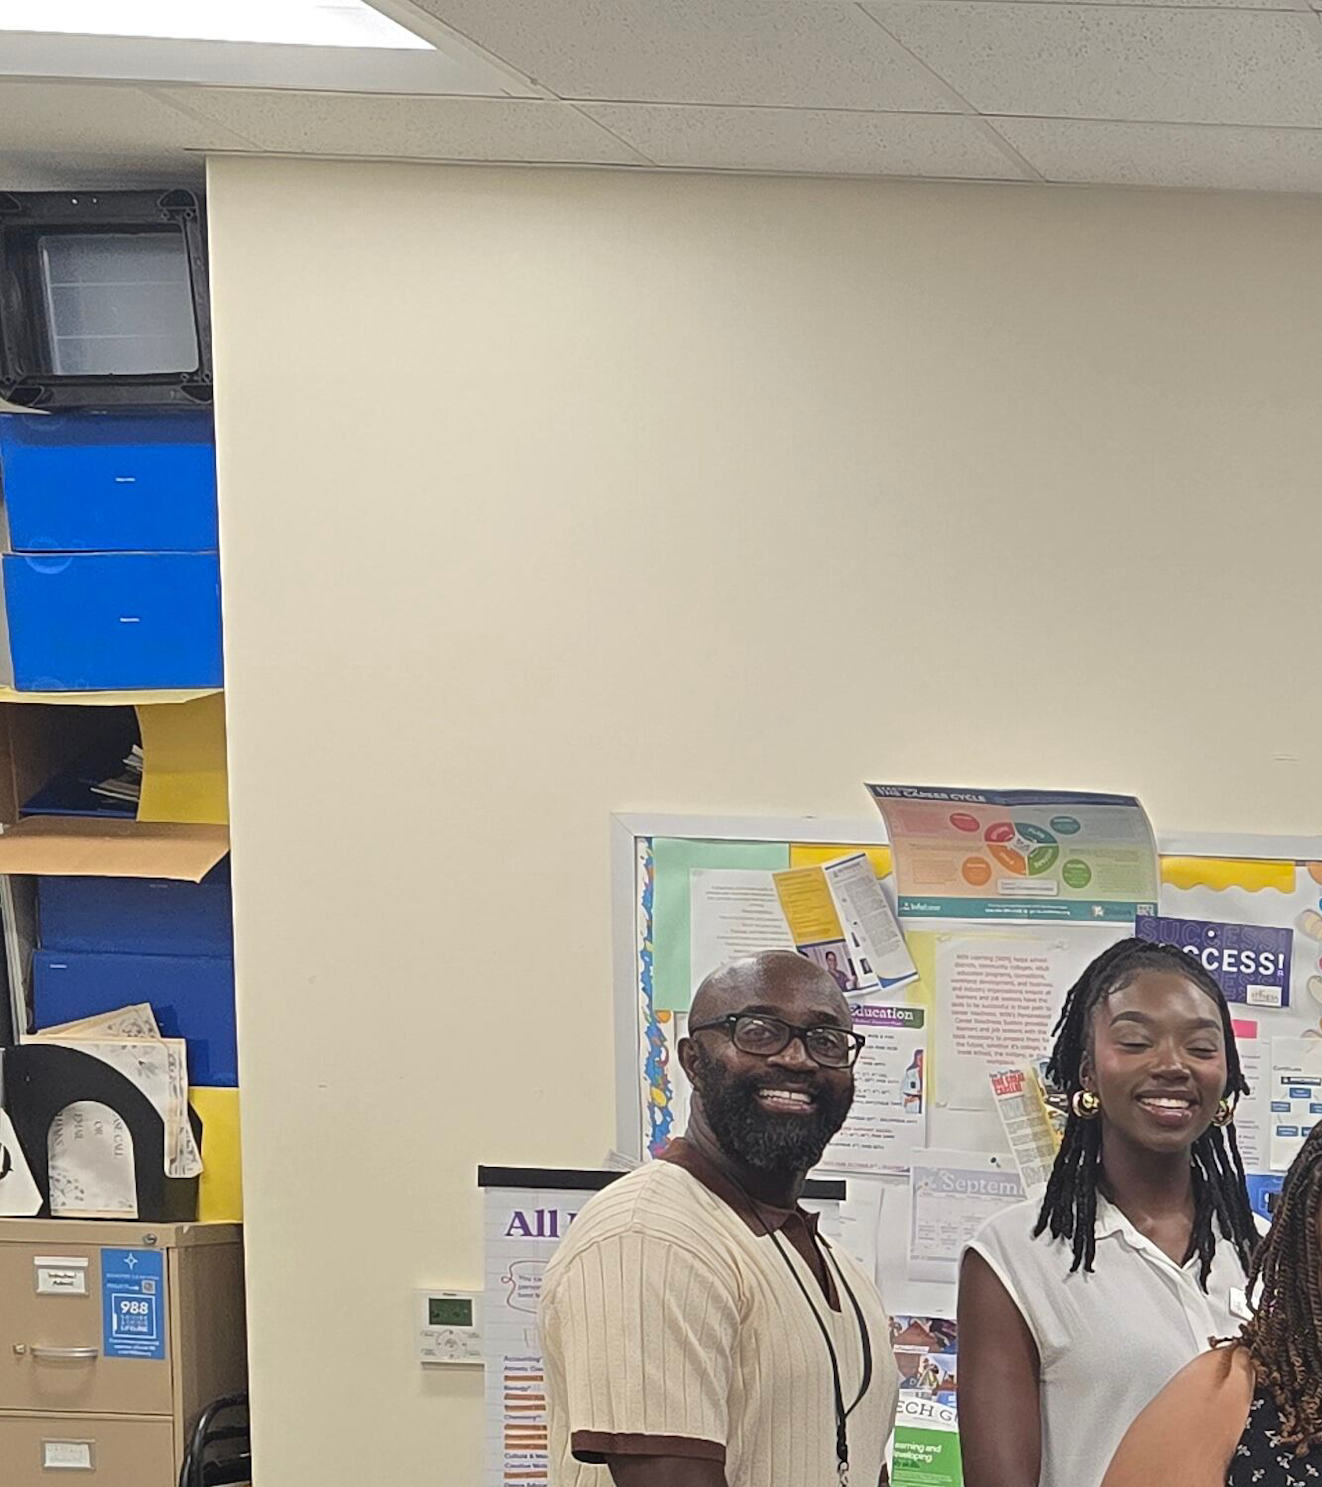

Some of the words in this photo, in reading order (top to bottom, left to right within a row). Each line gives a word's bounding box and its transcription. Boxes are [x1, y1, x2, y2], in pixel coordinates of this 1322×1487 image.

[942, 1173, 1024, 1195] Septem
[504, 1208, 560, 1239] All
[120, 1301, 149, 1315] 988
